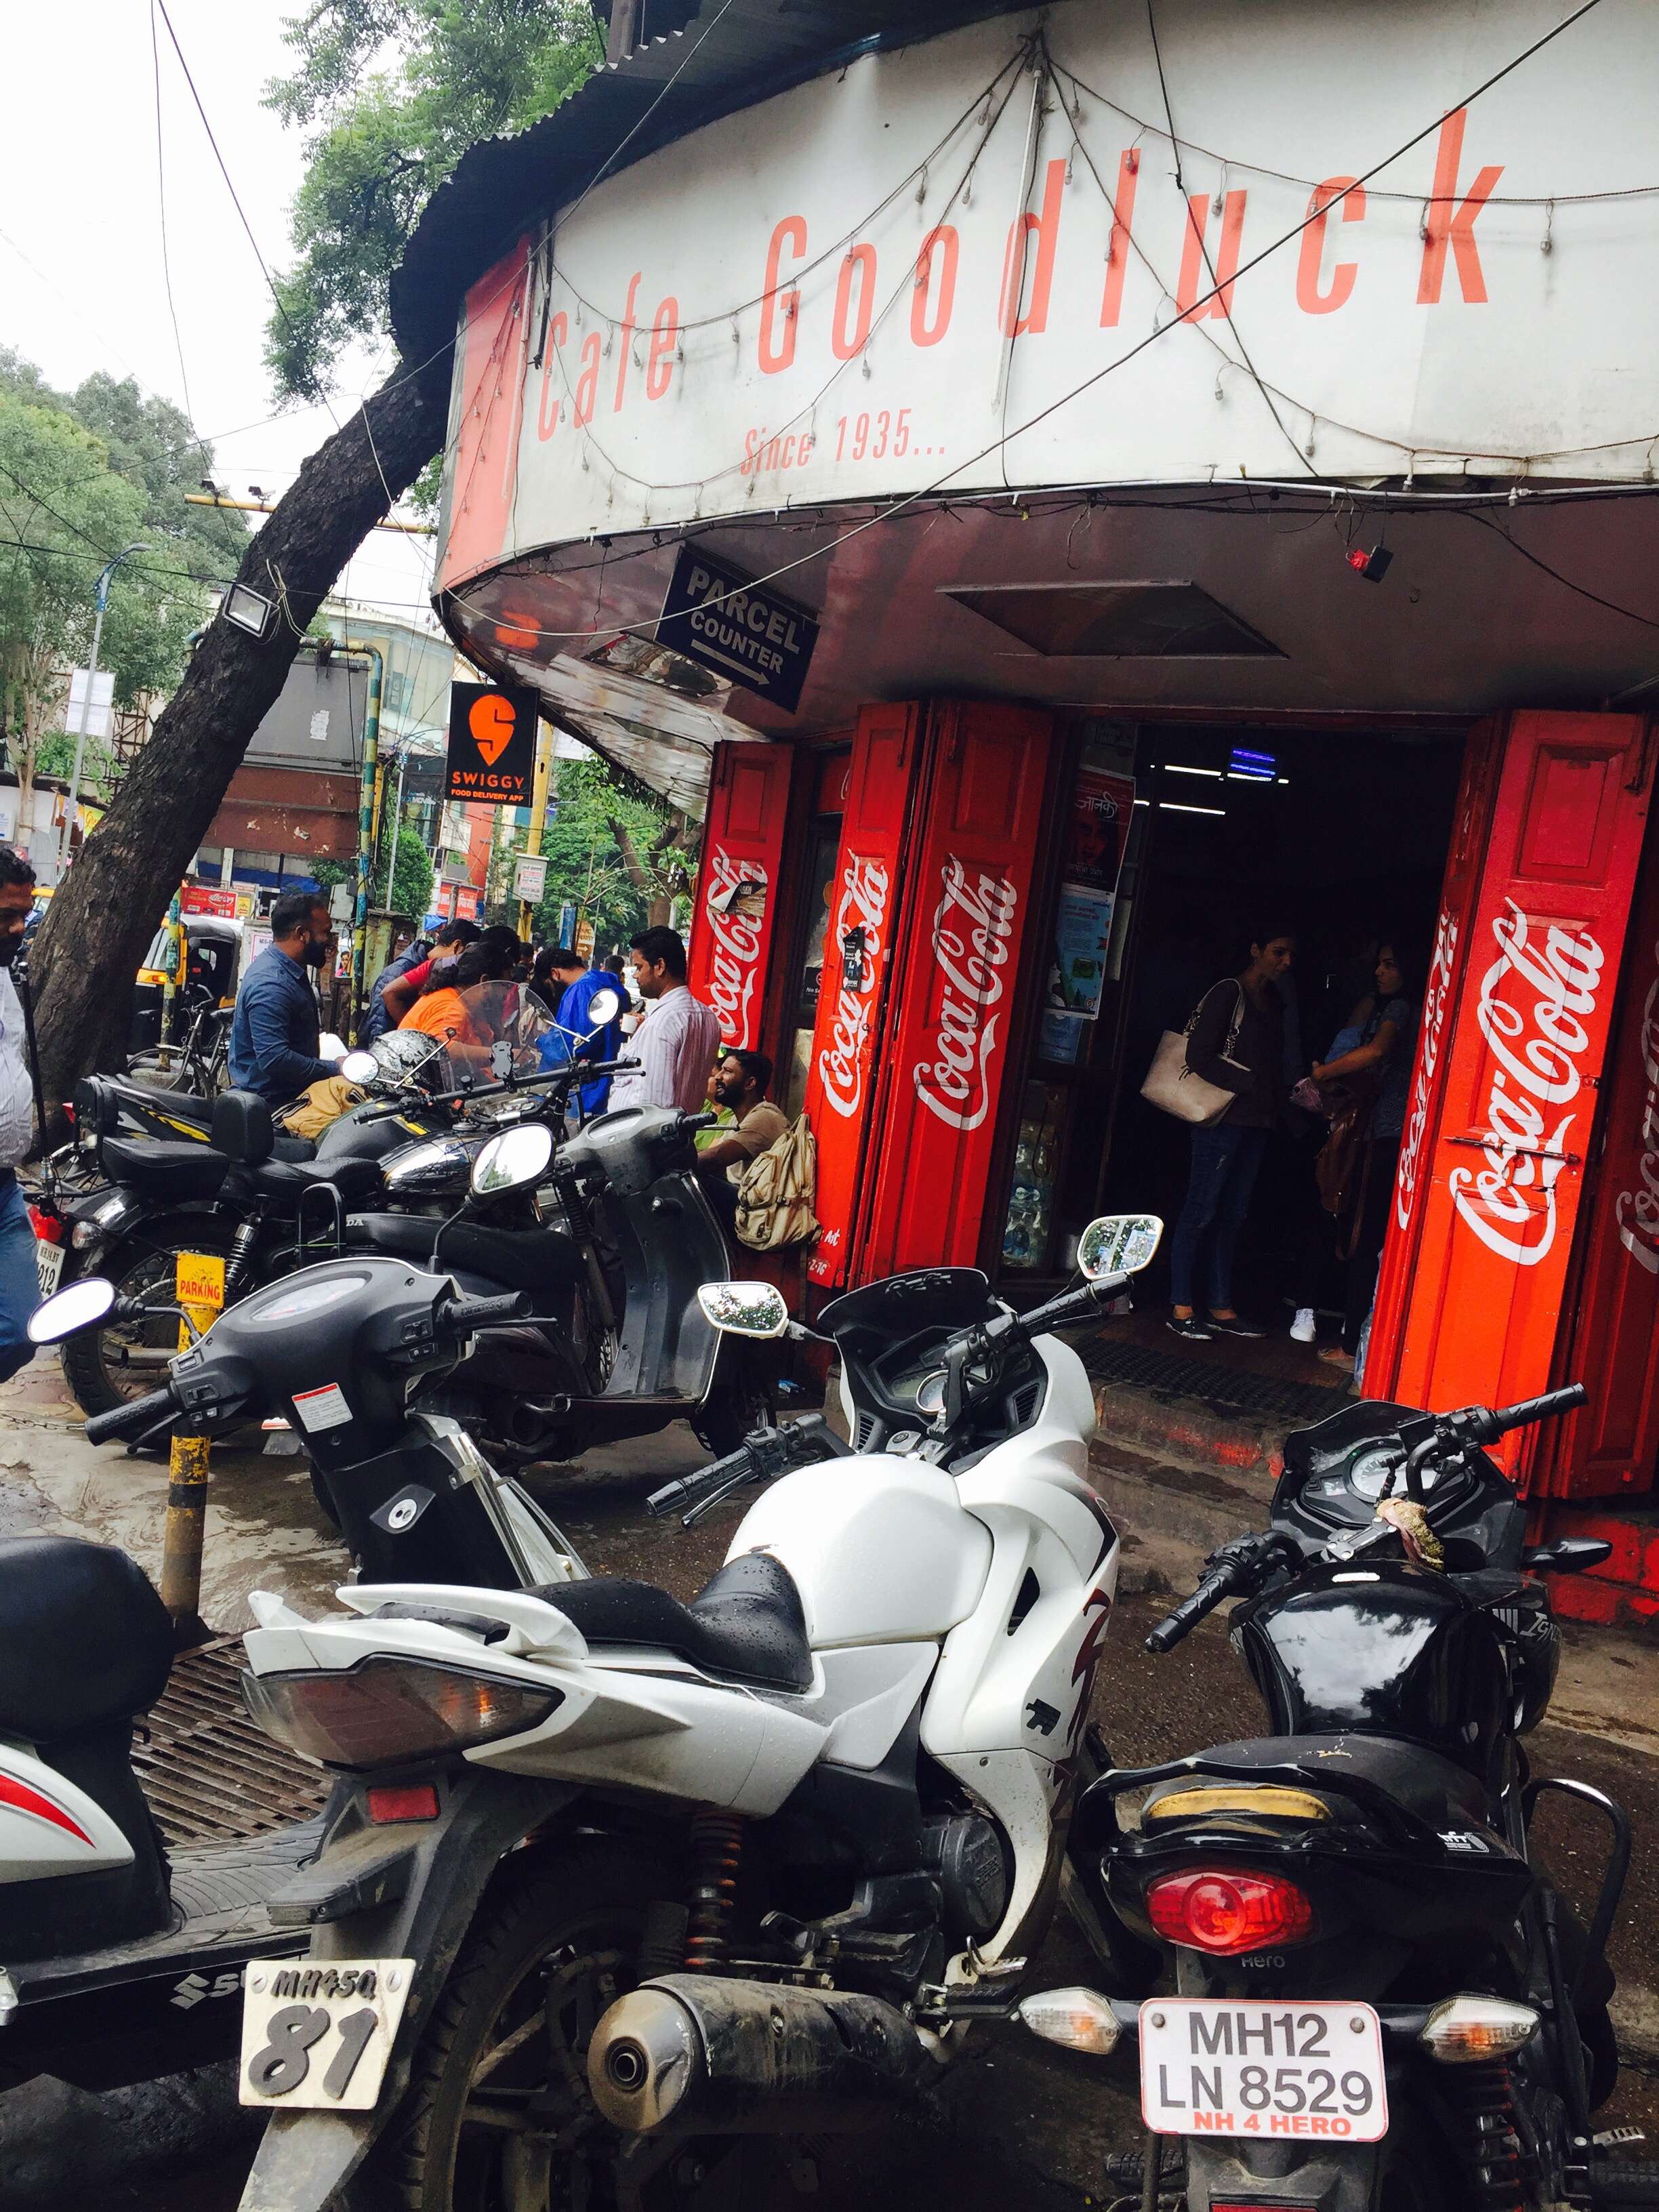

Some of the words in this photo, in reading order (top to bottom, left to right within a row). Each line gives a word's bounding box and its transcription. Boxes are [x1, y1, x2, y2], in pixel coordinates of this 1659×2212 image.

[537, 271, 679, 443] Cafe
[756, 108, 1506, 375] Goodluck
[740, 428, 811, 476] Since
[687, 565, 800, 655] PARCEL
[691, 611, 783, 674] COUNTER
[451, 771, 525, 790] SWIGGY
[472, 791, 508, 800] DELIVERY
[819, 848, 888, 1118] CocaCola
[180, 1279, 220, 1300] PARKING
[1242, 1954, 1285, 1968] Hero
[248, 2005, 379, 2102] 81
[1189, 2011, 1330, 2057] MH12
[1159, 2064, 1224, 2110] LN
[1239, 2065, 1373, 2116] 8529
[1193, 2111, 1234, 2131] NH
[1244, 2112, 1261, 2131] 4
[1270, 2114, 1352, 2137] HERO
